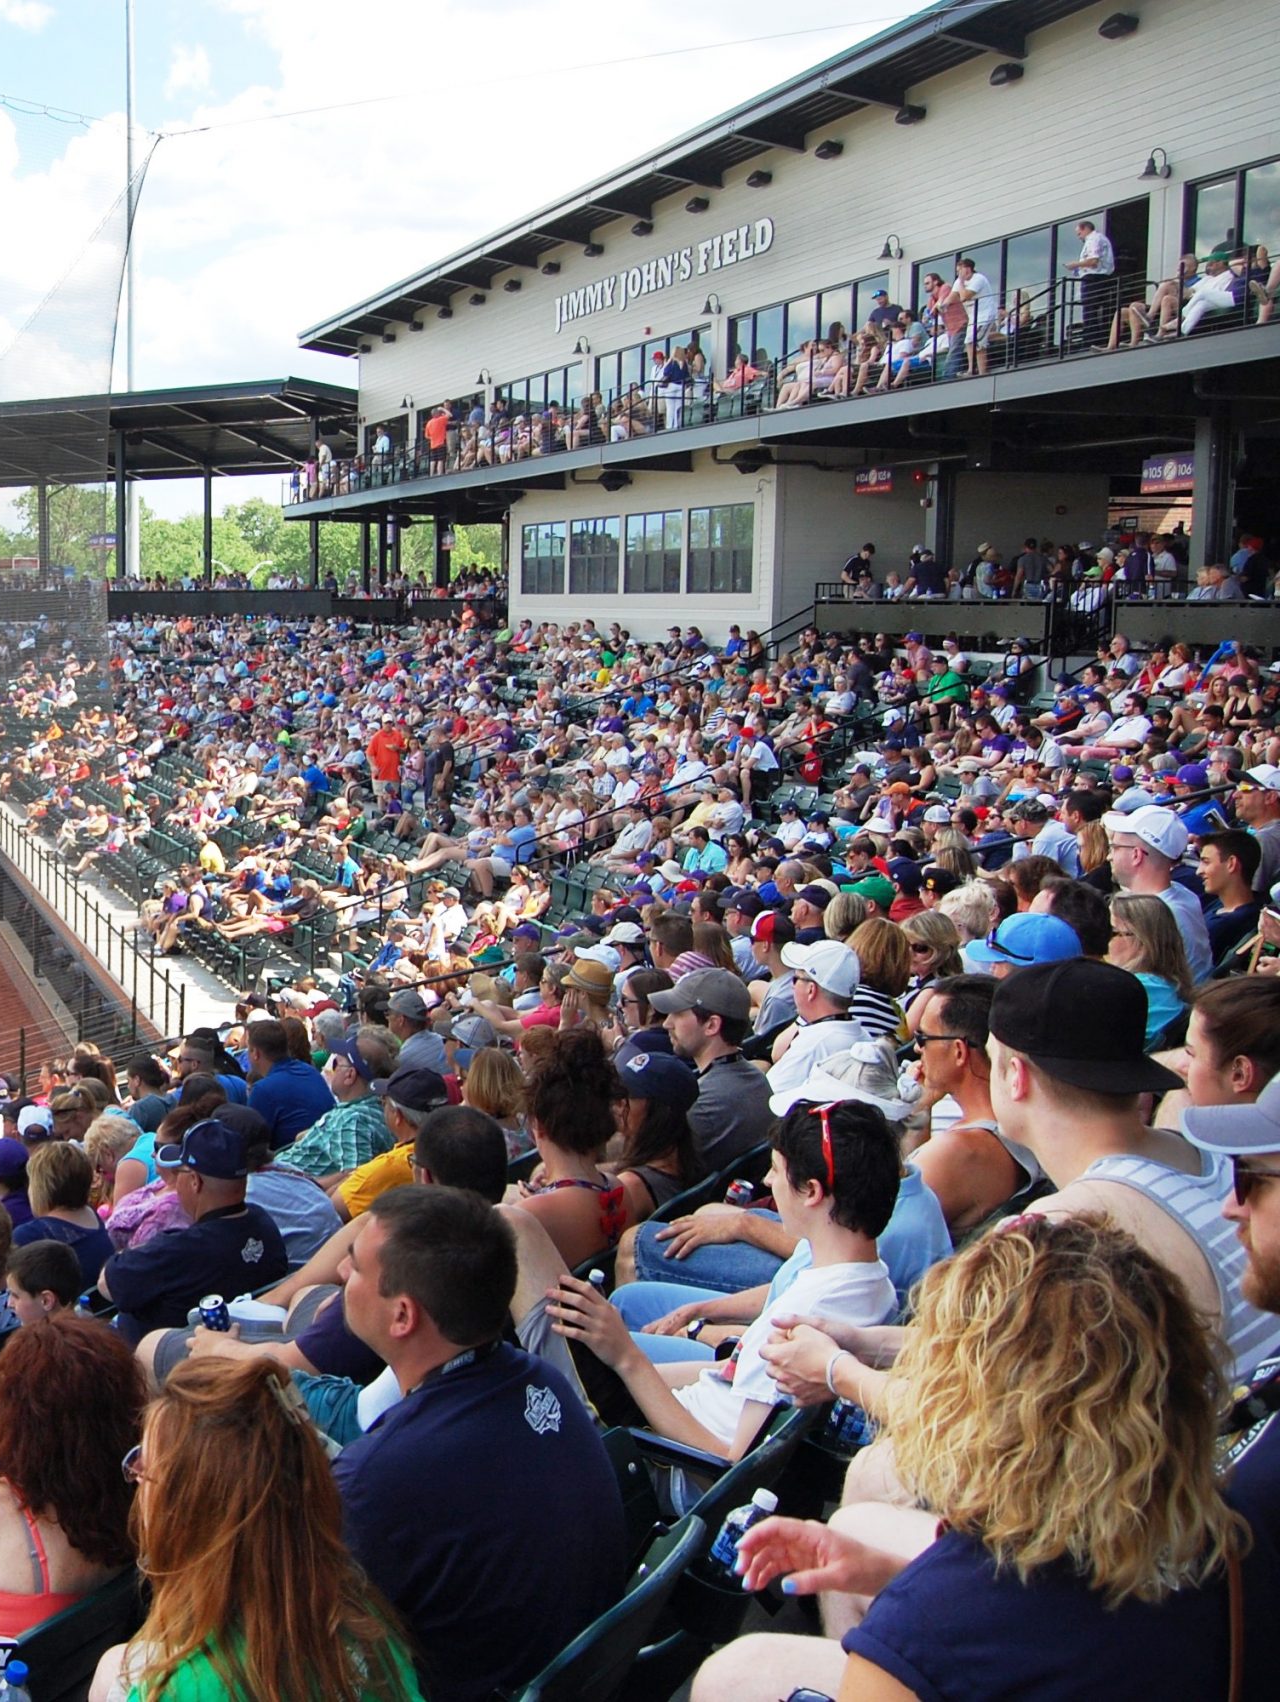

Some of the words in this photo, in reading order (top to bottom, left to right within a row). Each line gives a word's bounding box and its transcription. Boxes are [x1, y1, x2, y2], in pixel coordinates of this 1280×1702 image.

[555, 274, 618, 334] JIMMY
[619, 248, 694, 312] JOHN'S
[697, 216, 775, 275] FIELD
[1148, 465, 1162, 479] 105
[1178, 463, 1193, 477] 106
